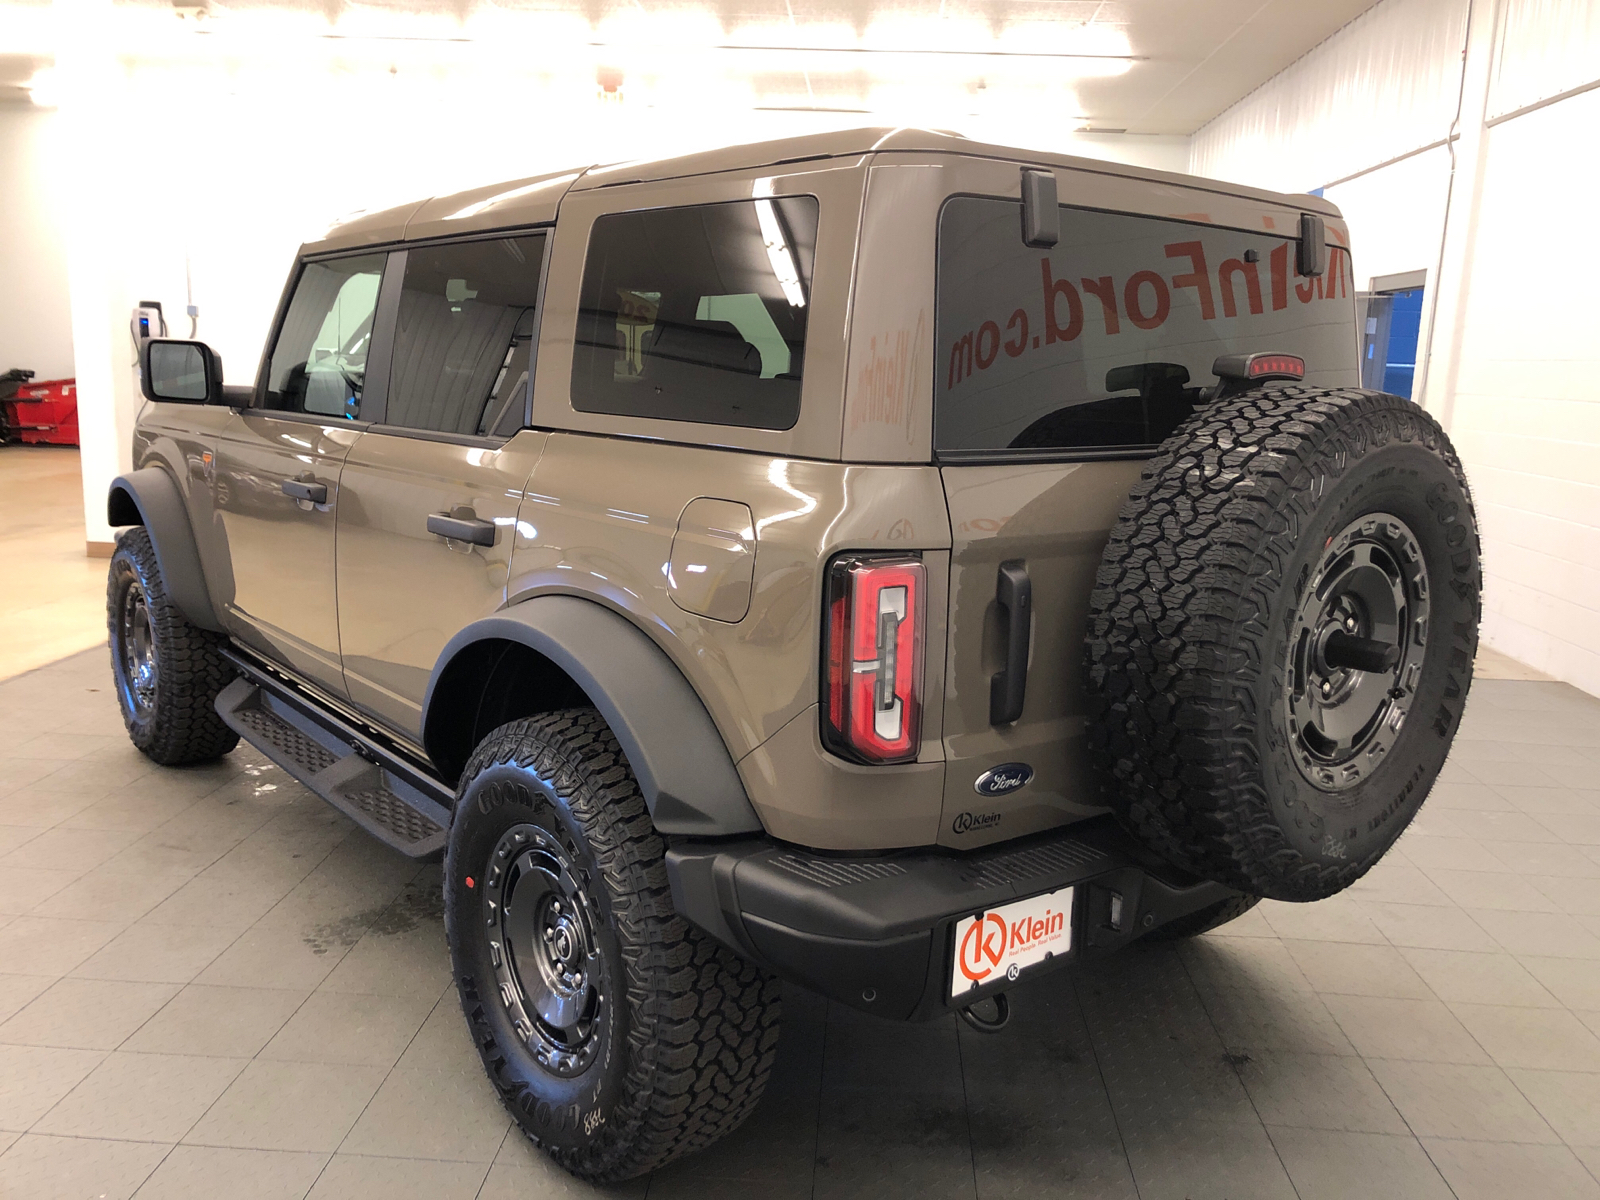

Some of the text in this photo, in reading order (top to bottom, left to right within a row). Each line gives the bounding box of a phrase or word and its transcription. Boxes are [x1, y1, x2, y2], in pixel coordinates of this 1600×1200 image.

[1426, 481, 1478, 740] GOODYEAR
[989, 772, 1022, 791] Ford
[973, 812, 1002, 826] Klein
[1010, 909, 1064, 949] Klein
